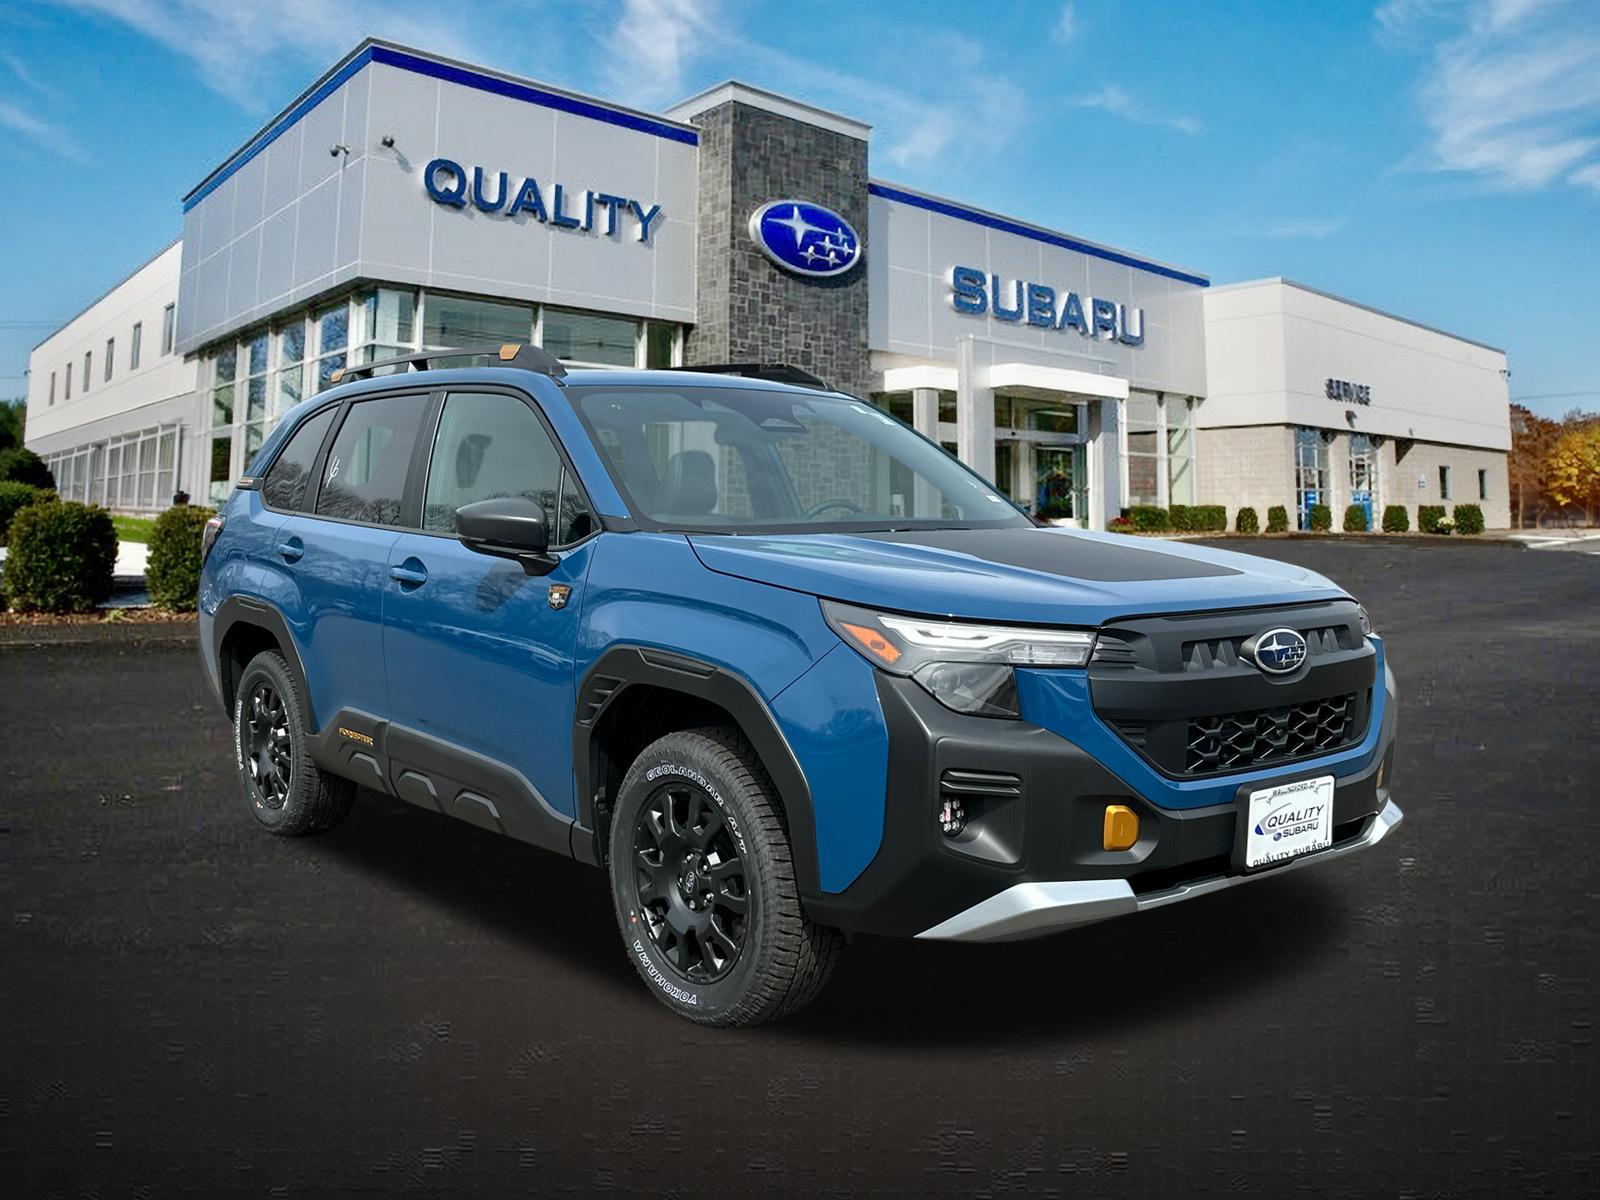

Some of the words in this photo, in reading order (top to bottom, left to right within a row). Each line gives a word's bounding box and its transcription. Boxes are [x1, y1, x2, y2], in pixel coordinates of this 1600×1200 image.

[423, 157, 662, 243] QUALITY
[950, 265, 1146, 346] SUBARU
[1267, 803, 1325, 828] QUALITY
[1282, 821, 1319, 838] SUBARU
[1252, 851, 1290, 866] QUALITY
[1293, 841, 1330, 855] SUBARU
[633, 939, 698, 1005] YOKOHAMA
